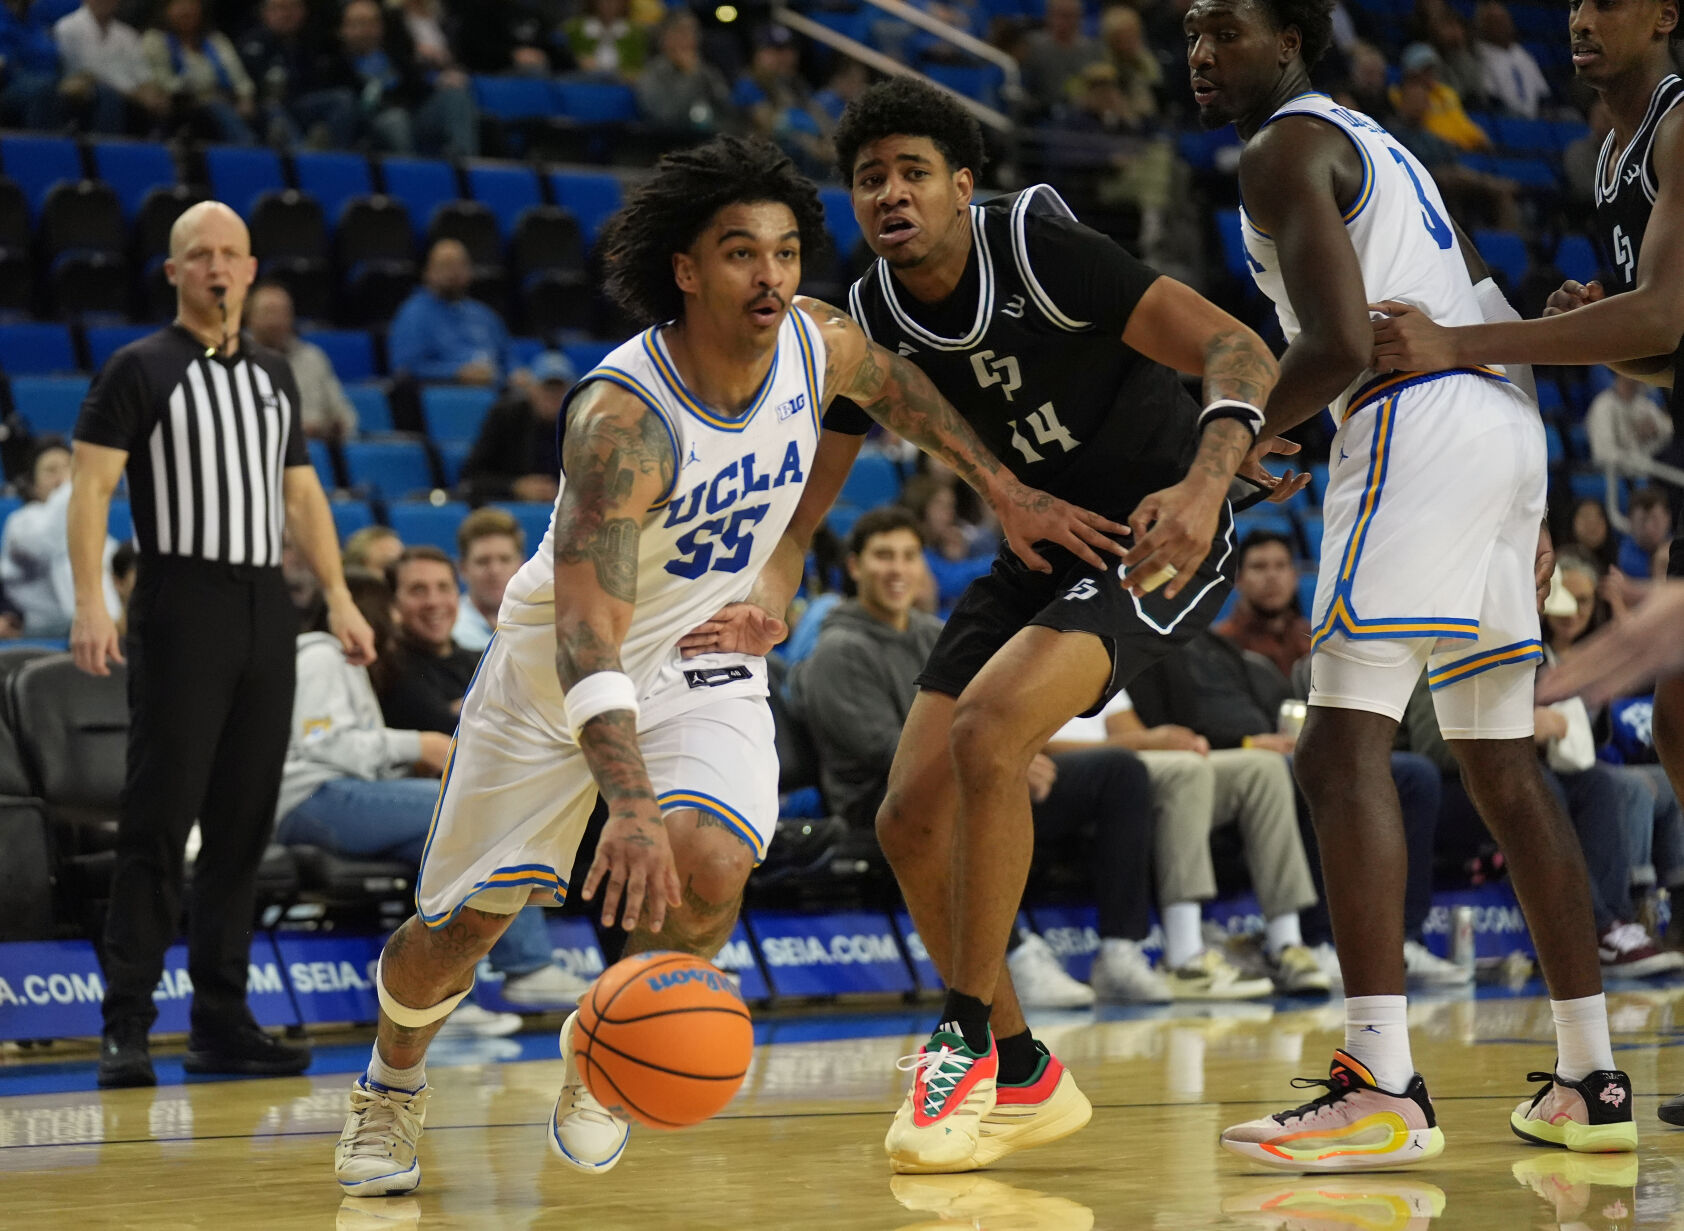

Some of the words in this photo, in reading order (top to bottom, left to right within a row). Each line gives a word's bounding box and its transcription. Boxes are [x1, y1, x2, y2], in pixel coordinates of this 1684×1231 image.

[1007, 401, 1082, 464] 14
[663, 440, 803, 529] UCLA
[663, 502, 771, 580] 55
[761, 934, 900, 966] SEIA.COM
